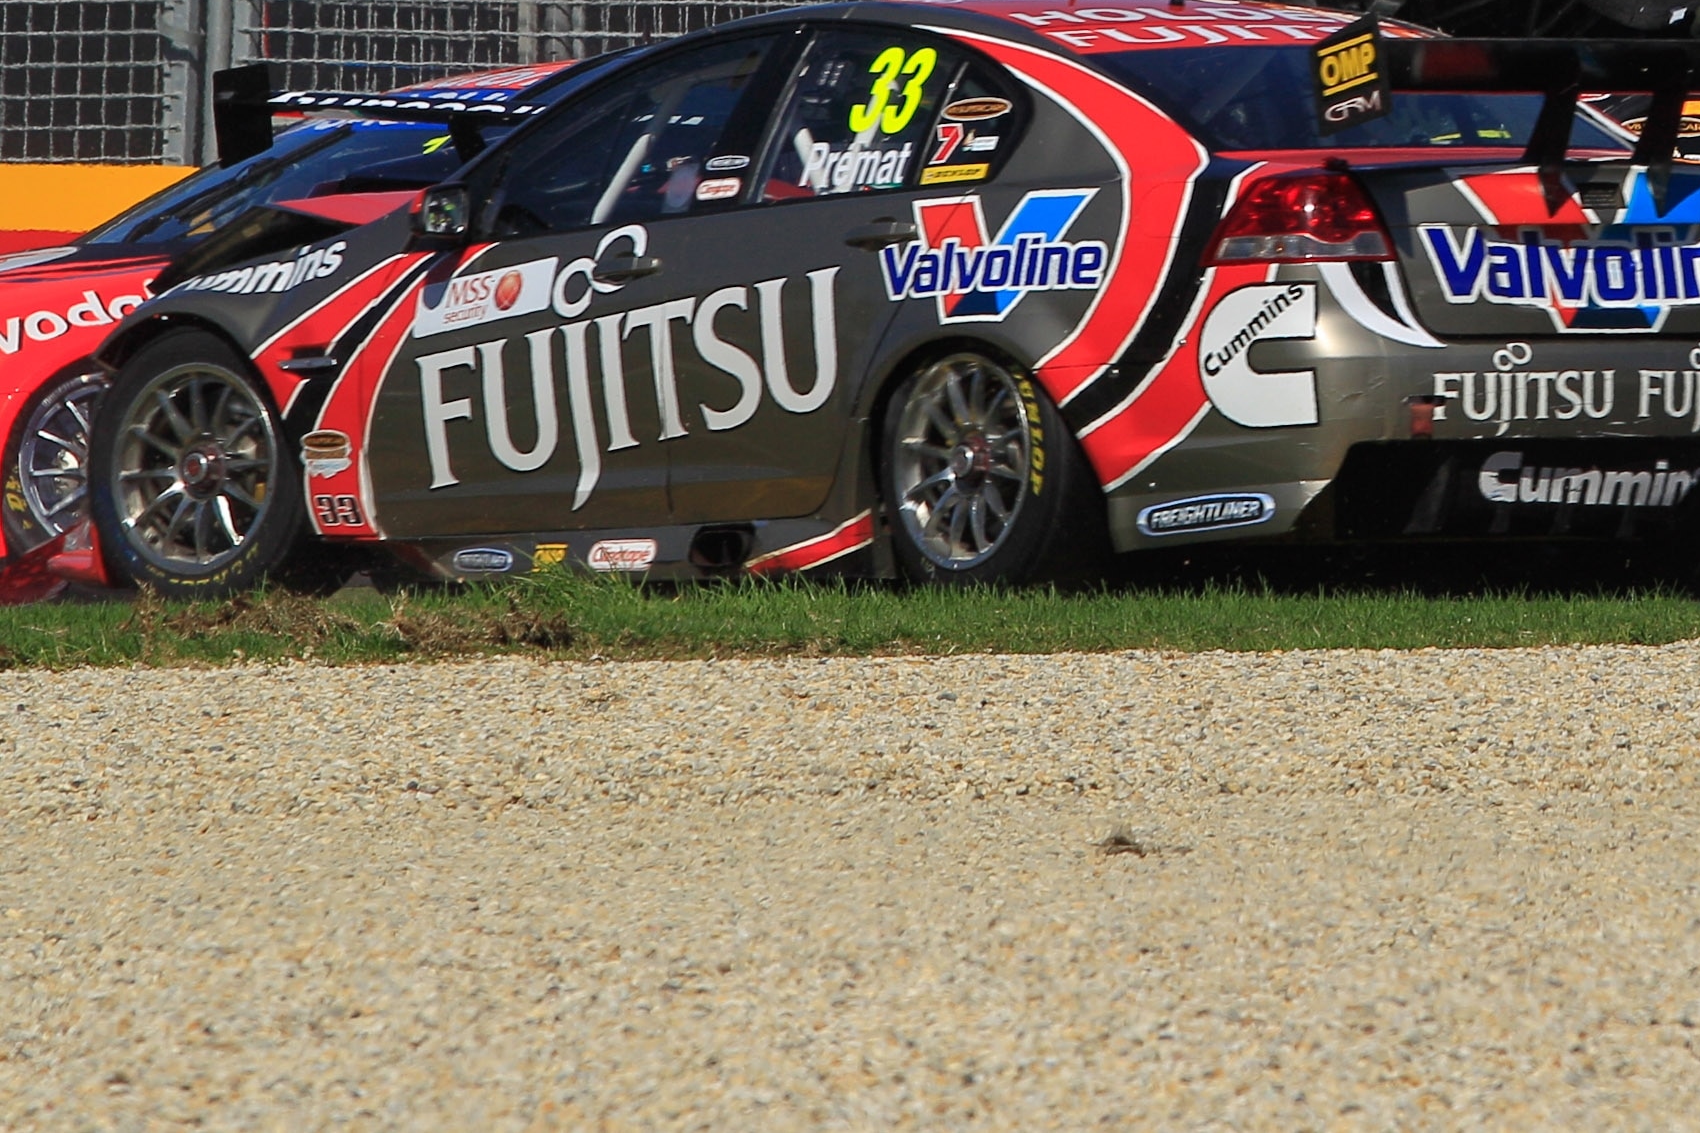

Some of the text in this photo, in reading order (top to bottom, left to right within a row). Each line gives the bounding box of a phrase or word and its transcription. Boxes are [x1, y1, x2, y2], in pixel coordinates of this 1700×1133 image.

[849, 47, 938, 135] 33
[1320, 42, 1376, 86] OMP
[158, 241, 347, 298] ummins
[446, 275, 493, 309] MSS
[879, 233, 1108, 301] Valvoline
[0, 280, 152, 354] voda
[1204, 283, 1305, 377] Cummins
[415, 265, 838, 513] FUJITSU
[1432, 368, 1616, 436] FUJITSU
[315, 495, 364, 526] 33
[1151, 500, 1262, 529] FREIGHTLINER
